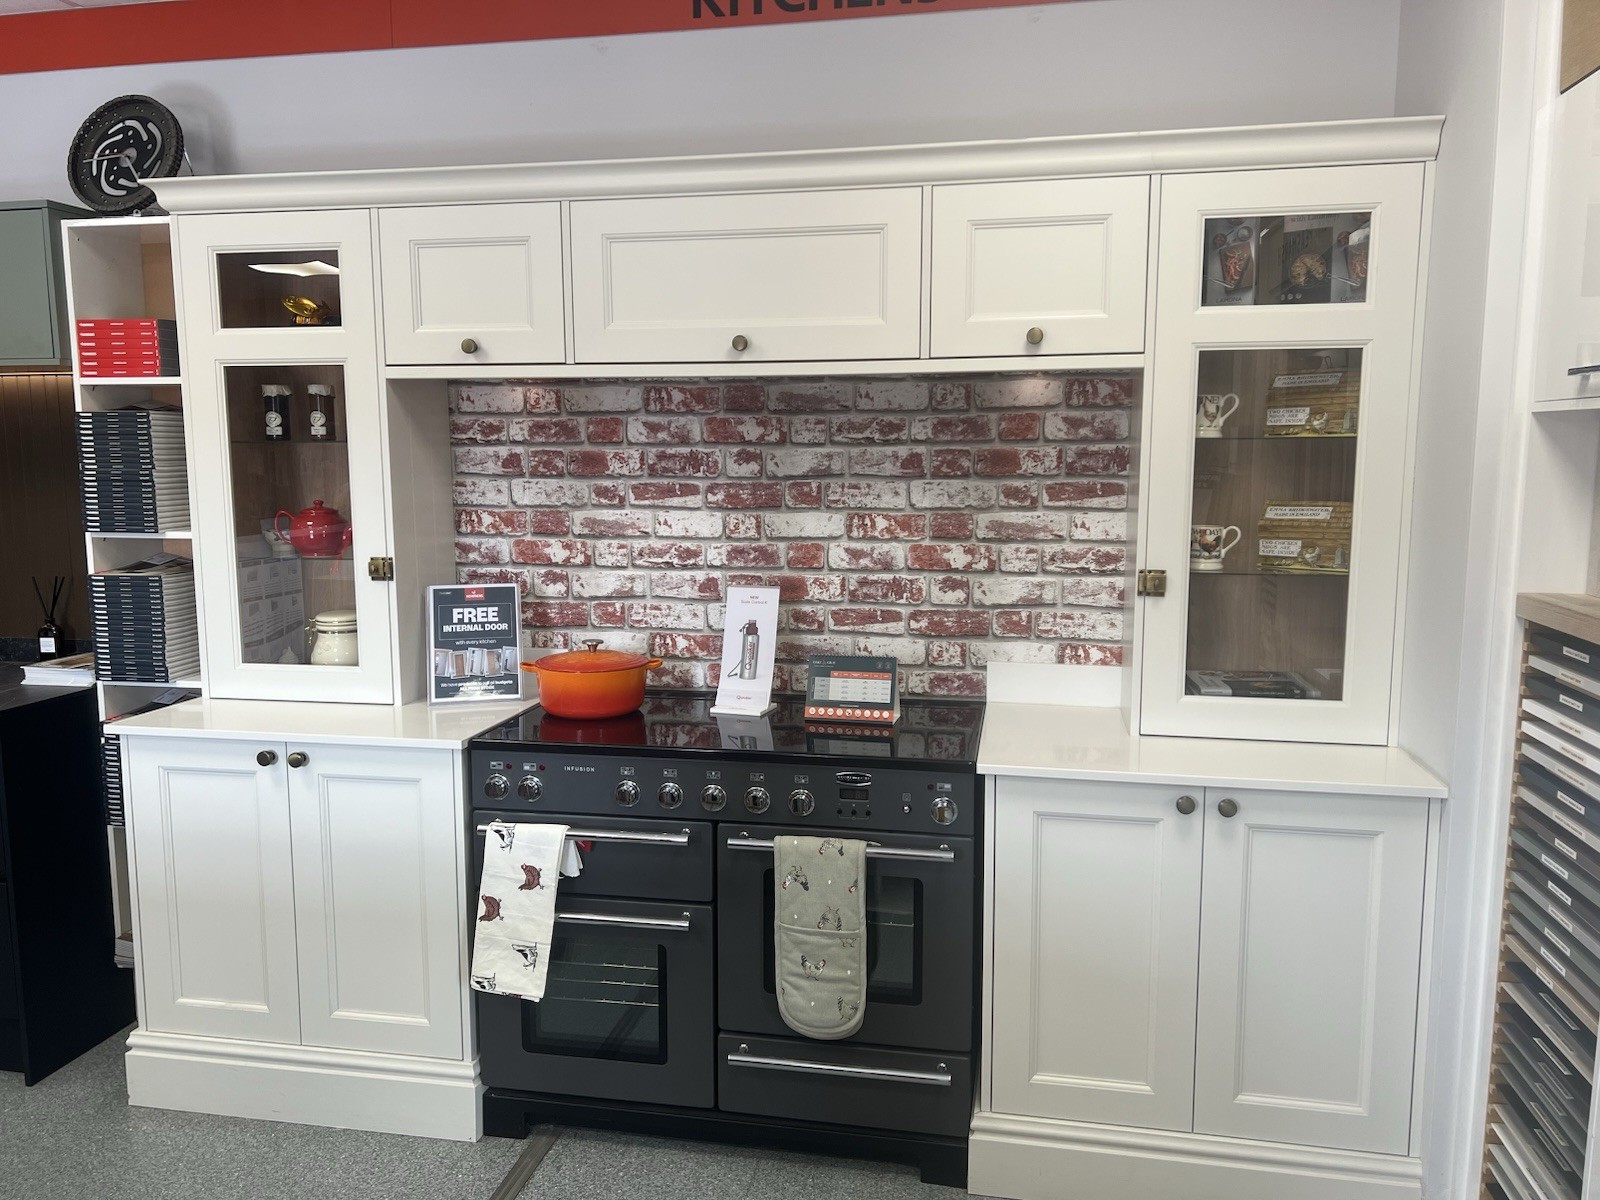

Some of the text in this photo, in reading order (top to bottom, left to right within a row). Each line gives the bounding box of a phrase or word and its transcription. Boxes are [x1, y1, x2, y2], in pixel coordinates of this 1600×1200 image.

[452, 606, 499, 624] FREE
[442, 623, 509, 633] INTERNAL DOOR
